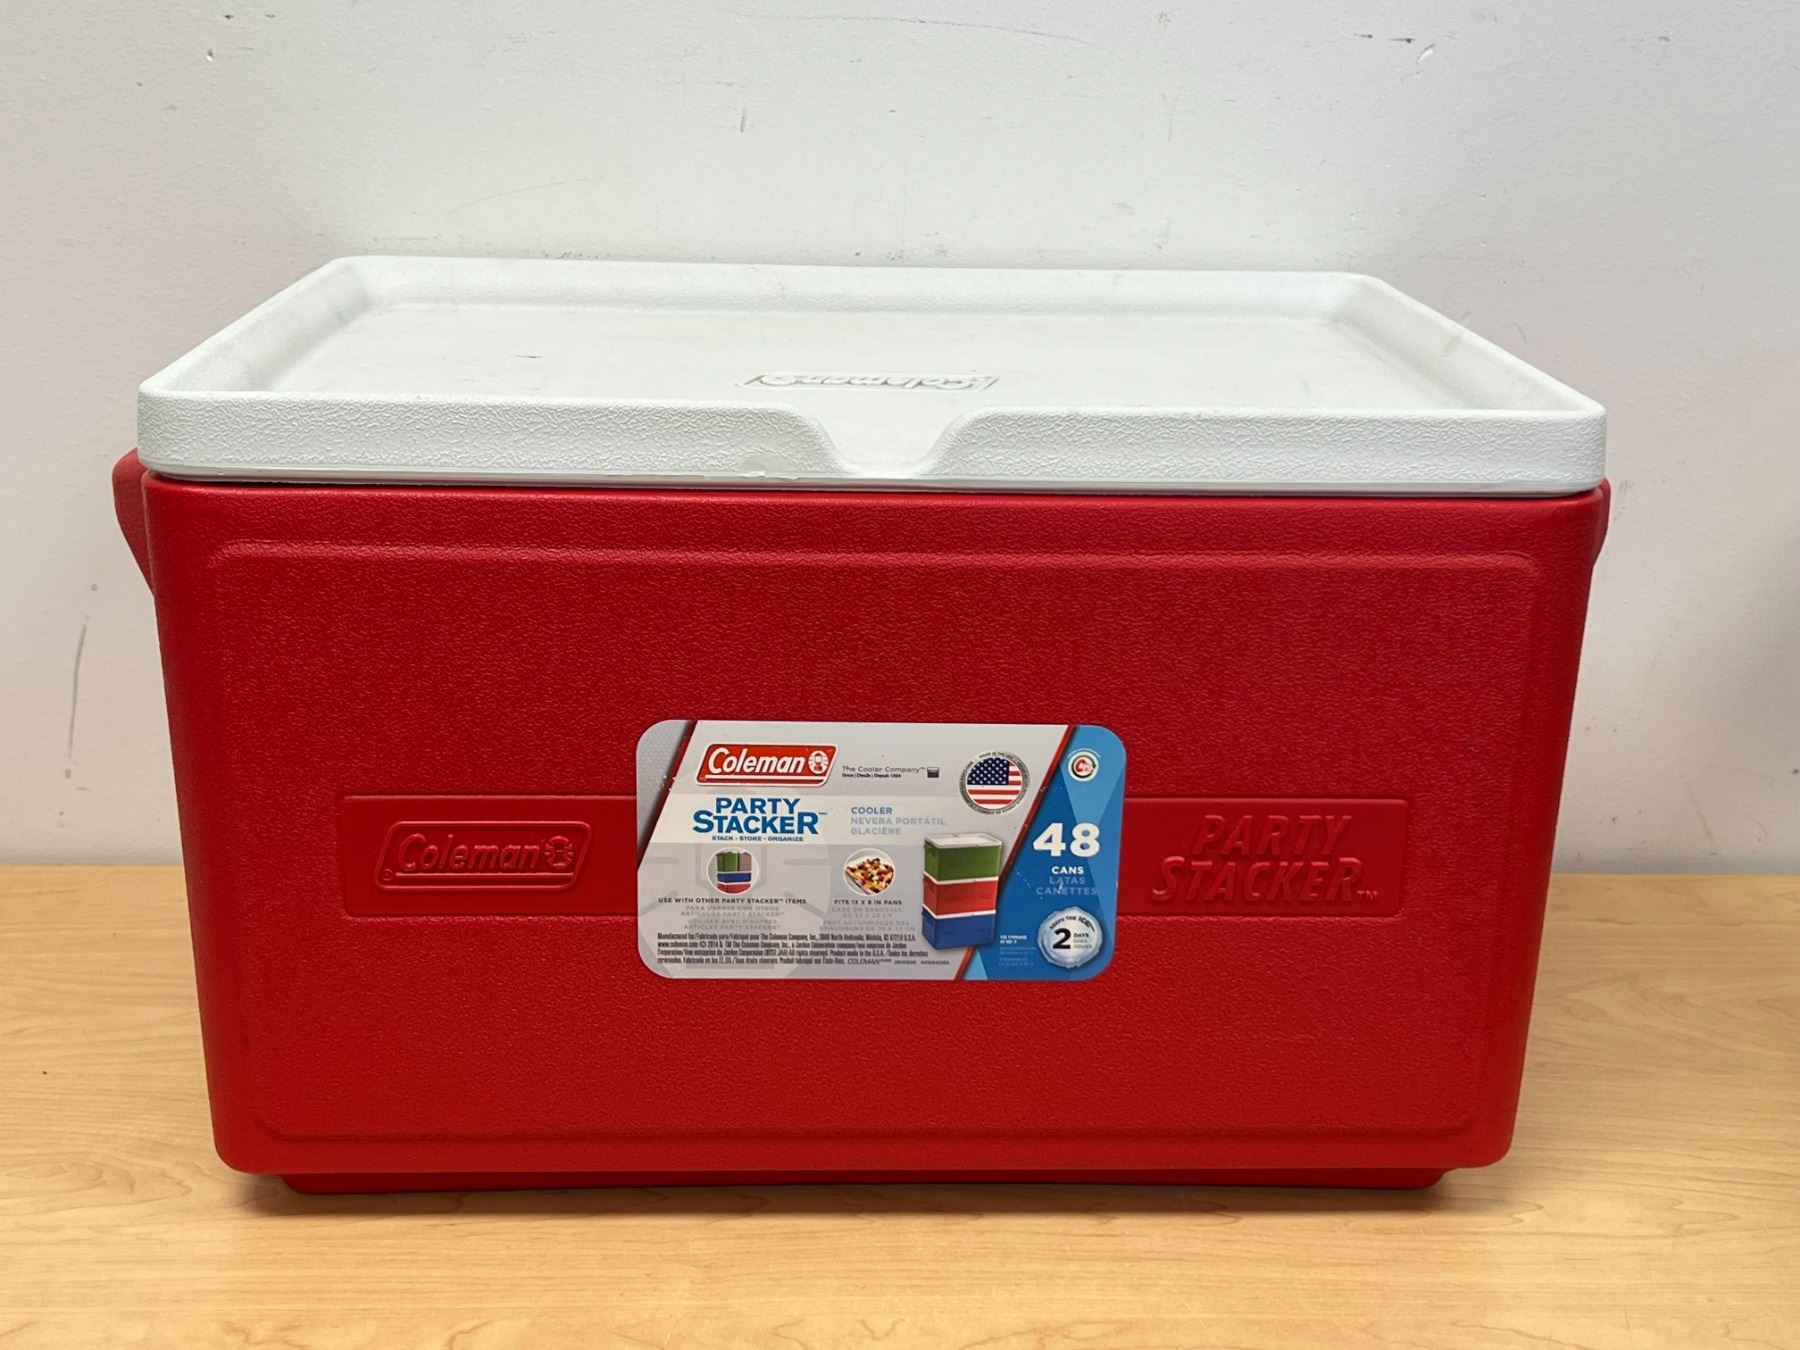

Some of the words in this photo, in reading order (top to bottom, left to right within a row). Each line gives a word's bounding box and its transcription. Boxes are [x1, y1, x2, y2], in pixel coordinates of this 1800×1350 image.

[708, 748, 805, 774] Coleman
[715, 798, 801, 814] PARTY
[850, 806, 893, 815] COOLER
[850, 817, 893, 826] NEVERA
[896, 815, 946, 826] PORTÁTIL
[1032, 822, 1100, 858] 48
[1191, 815, 1352, 855] PARTY
[399, 832, 540, 872] Coleman
[1051, 866, 1084, 875] CANS
[1052, 928, 1071, 950] 2
